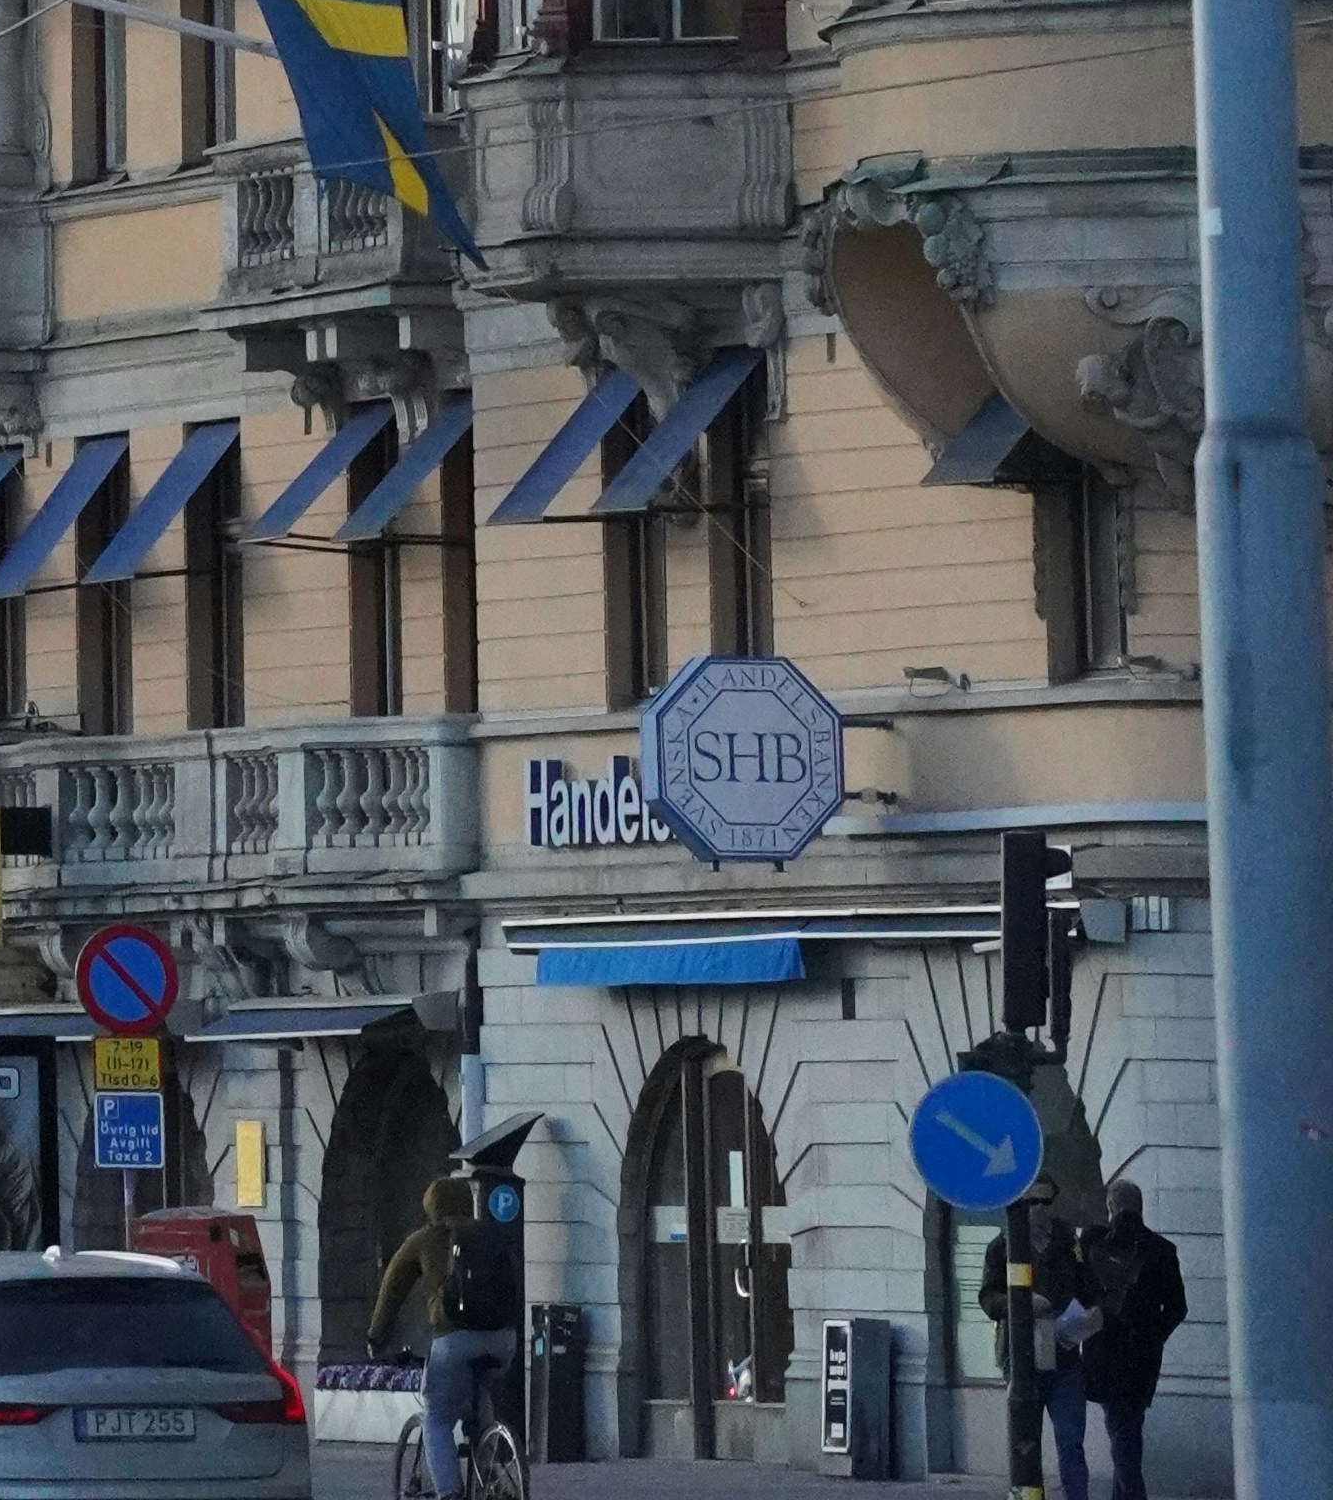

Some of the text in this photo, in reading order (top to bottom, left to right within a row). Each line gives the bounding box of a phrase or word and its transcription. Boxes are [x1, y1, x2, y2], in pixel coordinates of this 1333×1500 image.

[693, 730, 807, 784] SHB
[729, 827, 779, 849] 1871
[101, 1073, 129, 1087] Tisd
[100, 1120, 159, 1137] Övrig tid
[110, 1136, 151, 1151] Avgift
[108, 1149, 153, 1162] Taxa 2
[95, 1411, 186, 1433] PJT 255
